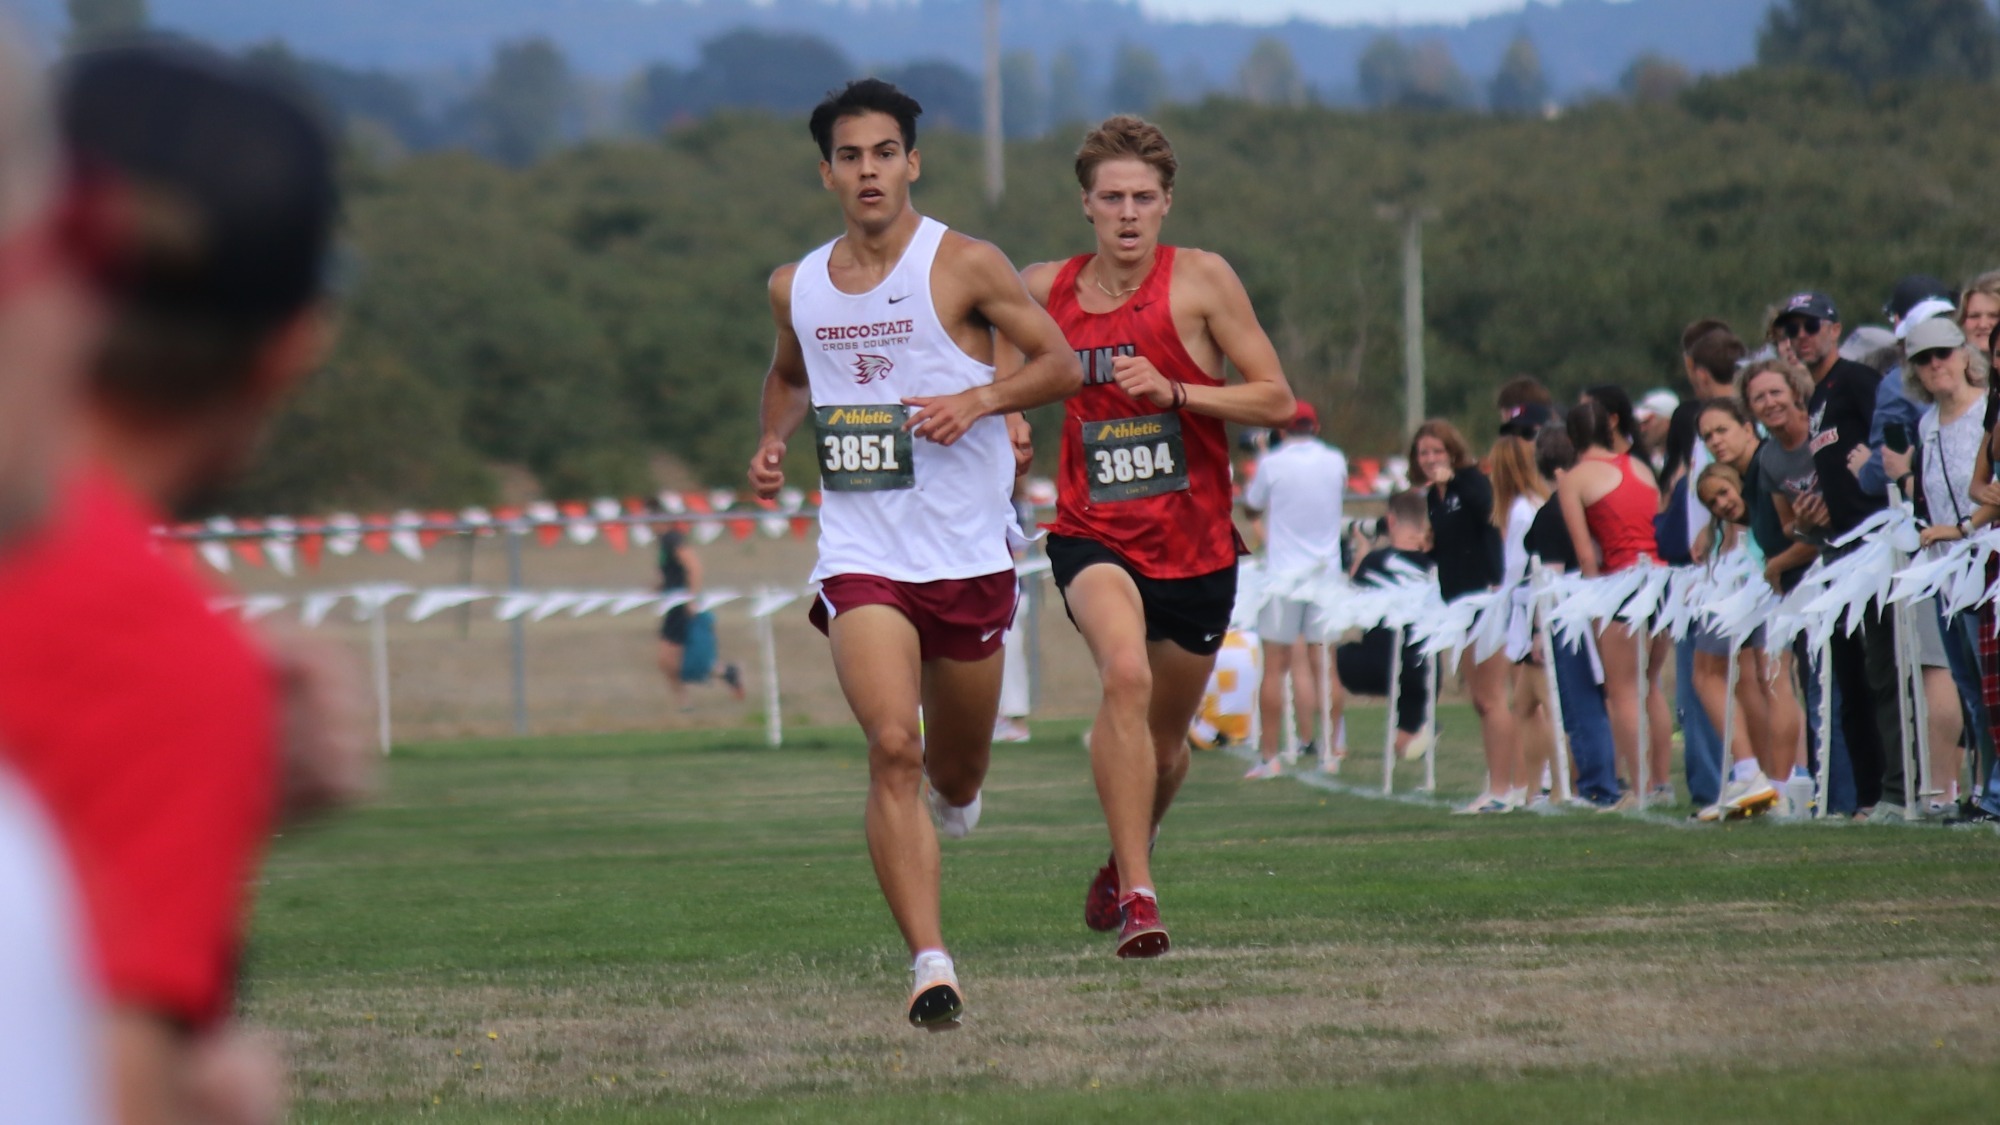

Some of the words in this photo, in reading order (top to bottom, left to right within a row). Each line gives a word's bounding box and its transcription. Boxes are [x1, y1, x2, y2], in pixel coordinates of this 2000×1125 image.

[822, 342, 859, 351] CROSS
[863, 336, 911, 349] COUNTRY
[828, 408, 893, 425] Athletic
[1097, 422, 1162, 441] Athletic
[824, 434, 899, 472] 3851
[1094, 442, 1175, 484] 3894
